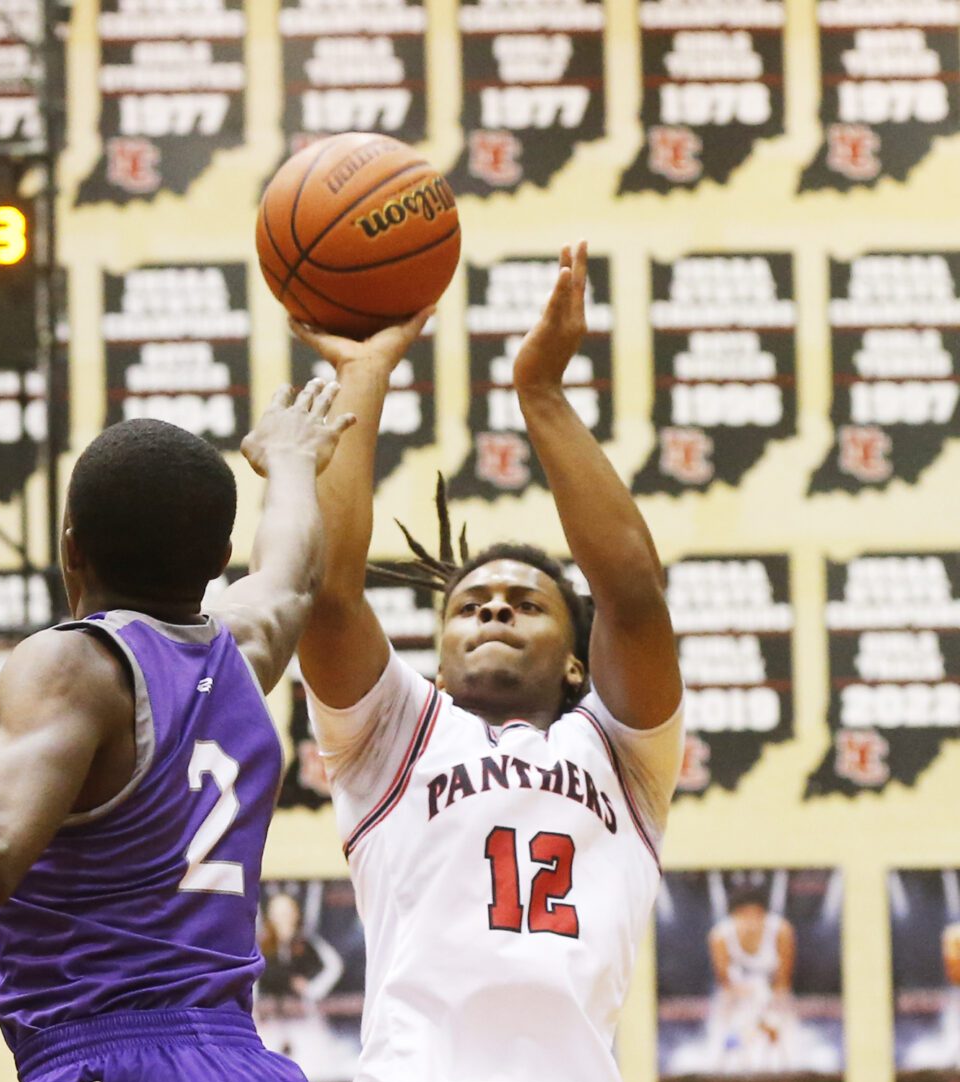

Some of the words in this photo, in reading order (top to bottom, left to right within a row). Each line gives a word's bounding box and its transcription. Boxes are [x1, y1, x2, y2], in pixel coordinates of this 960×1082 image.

[178, 739, 245, 897] 2
[426, 755, 617, 835] PANTHERS
[484, 825, 579, 939] 12
